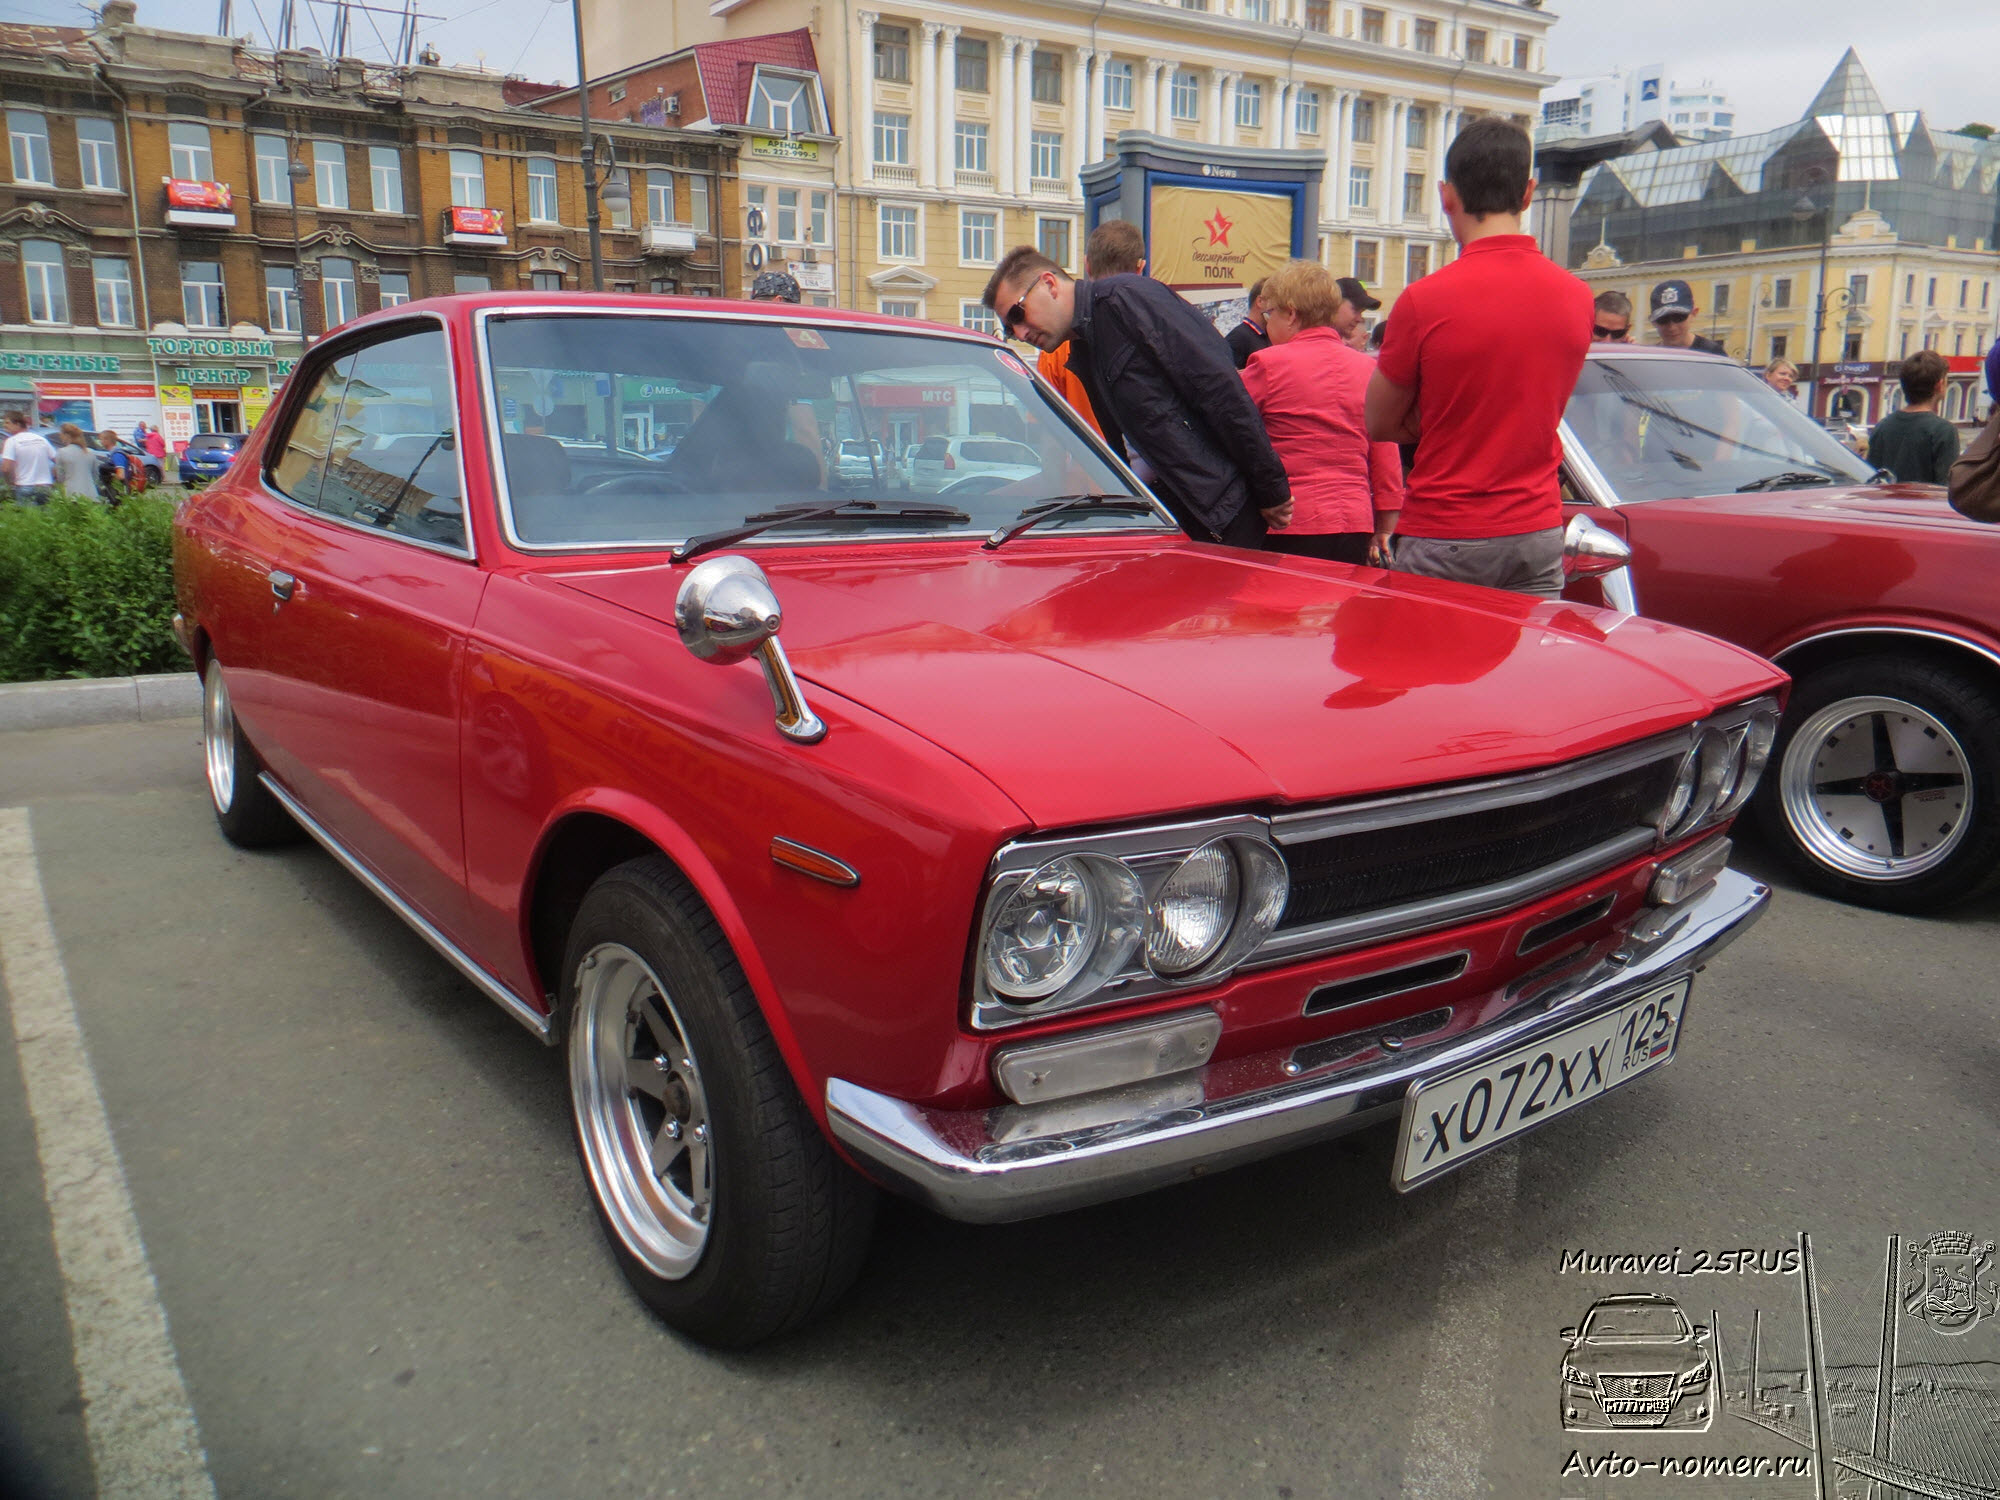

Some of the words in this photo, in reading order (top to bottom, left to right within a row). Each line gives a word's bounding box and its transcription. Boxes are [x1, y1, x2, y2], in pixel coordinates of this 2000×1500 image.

[767, 140, 804, 150] АРЕНДА
[773, 148, 817, 158] 222-999-5
[1211, 165, 1237, 178] News
[1204, 266, 1235, 279] ПОЛК
[147, 338, 274, 356] ТОРГОВЫЙ
[175, 368, 251, 385] ЦЕНТР
[1620, 992, 1676, 1055] 125
[1620, 1048, 1650, 1073] RUS
